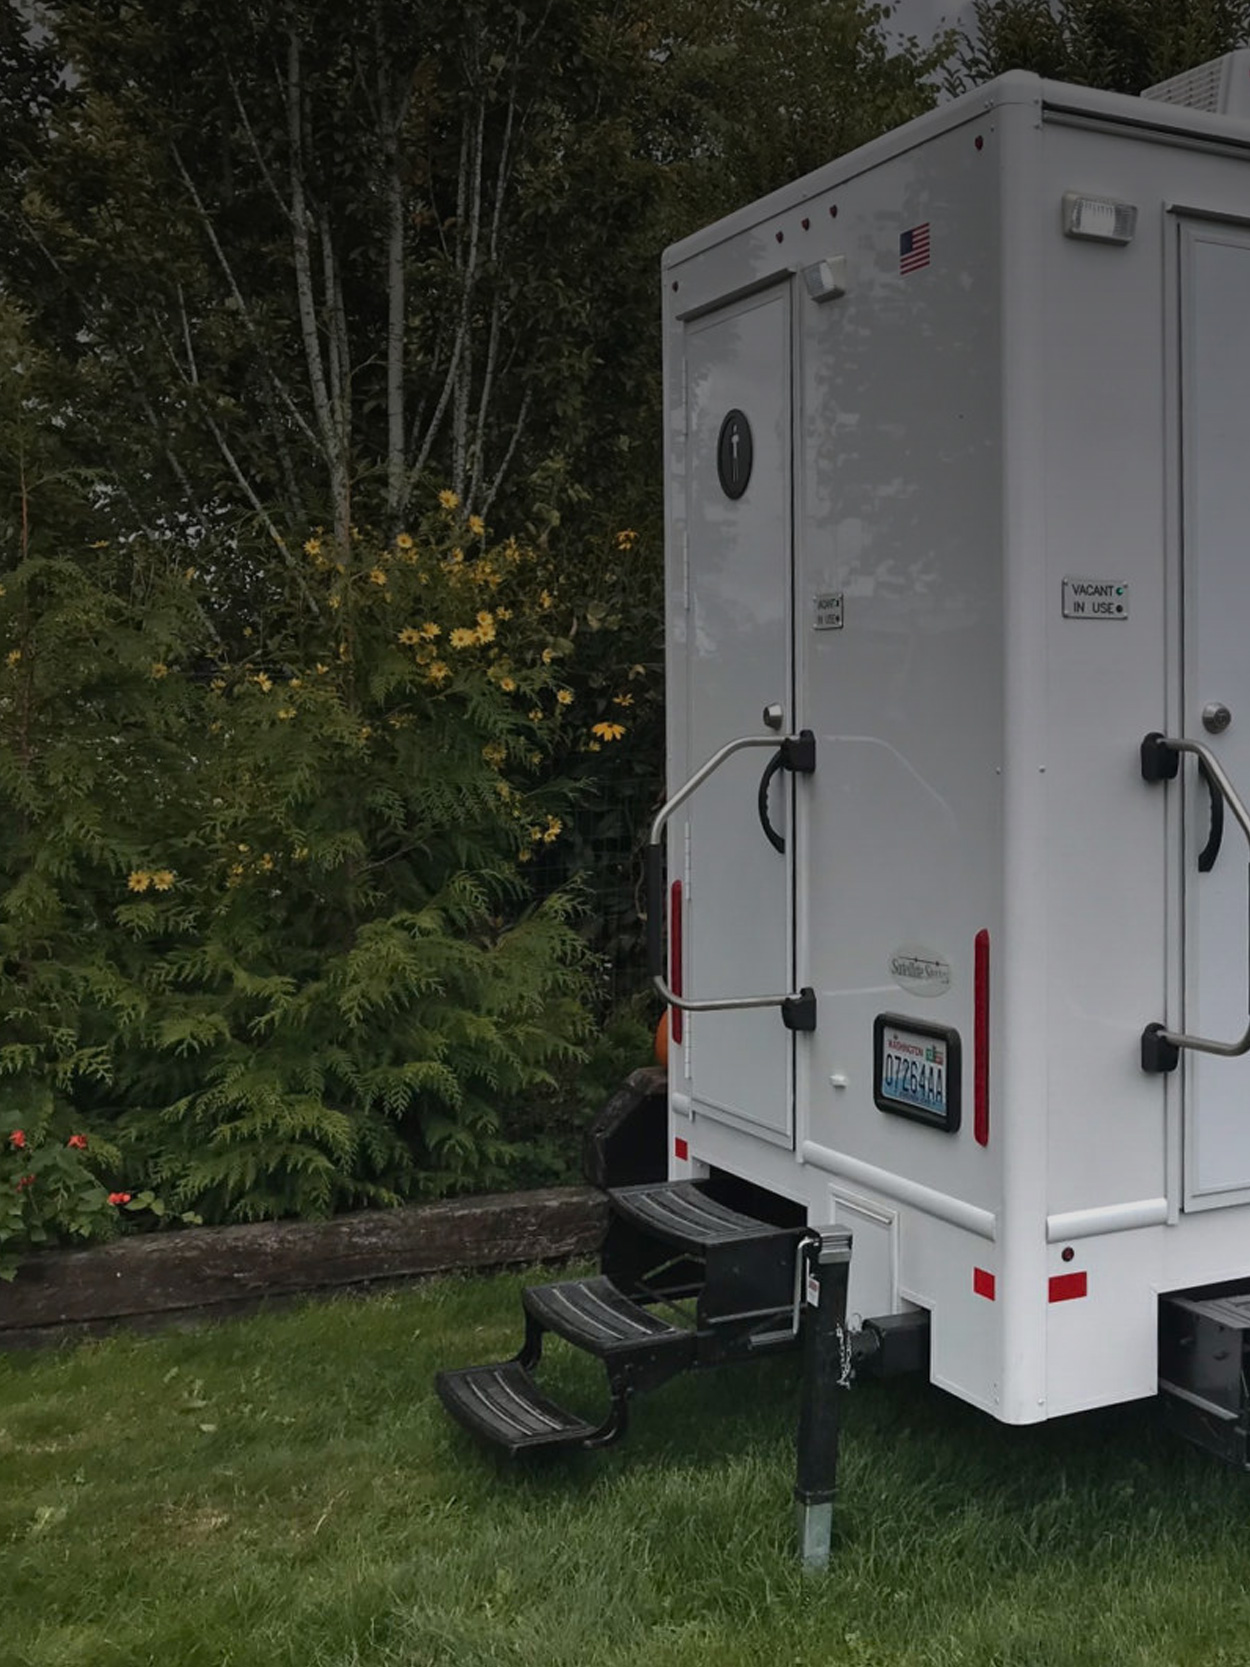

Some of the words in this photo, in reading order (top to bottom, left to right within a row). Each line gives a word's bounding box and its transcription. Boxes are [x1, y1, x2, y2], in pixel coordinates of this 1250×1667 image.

[1072, 584, 1114, 596] VACANT
[1073, 602, 1085, 613] IN
[1092, 602, 1114, 614] USE
